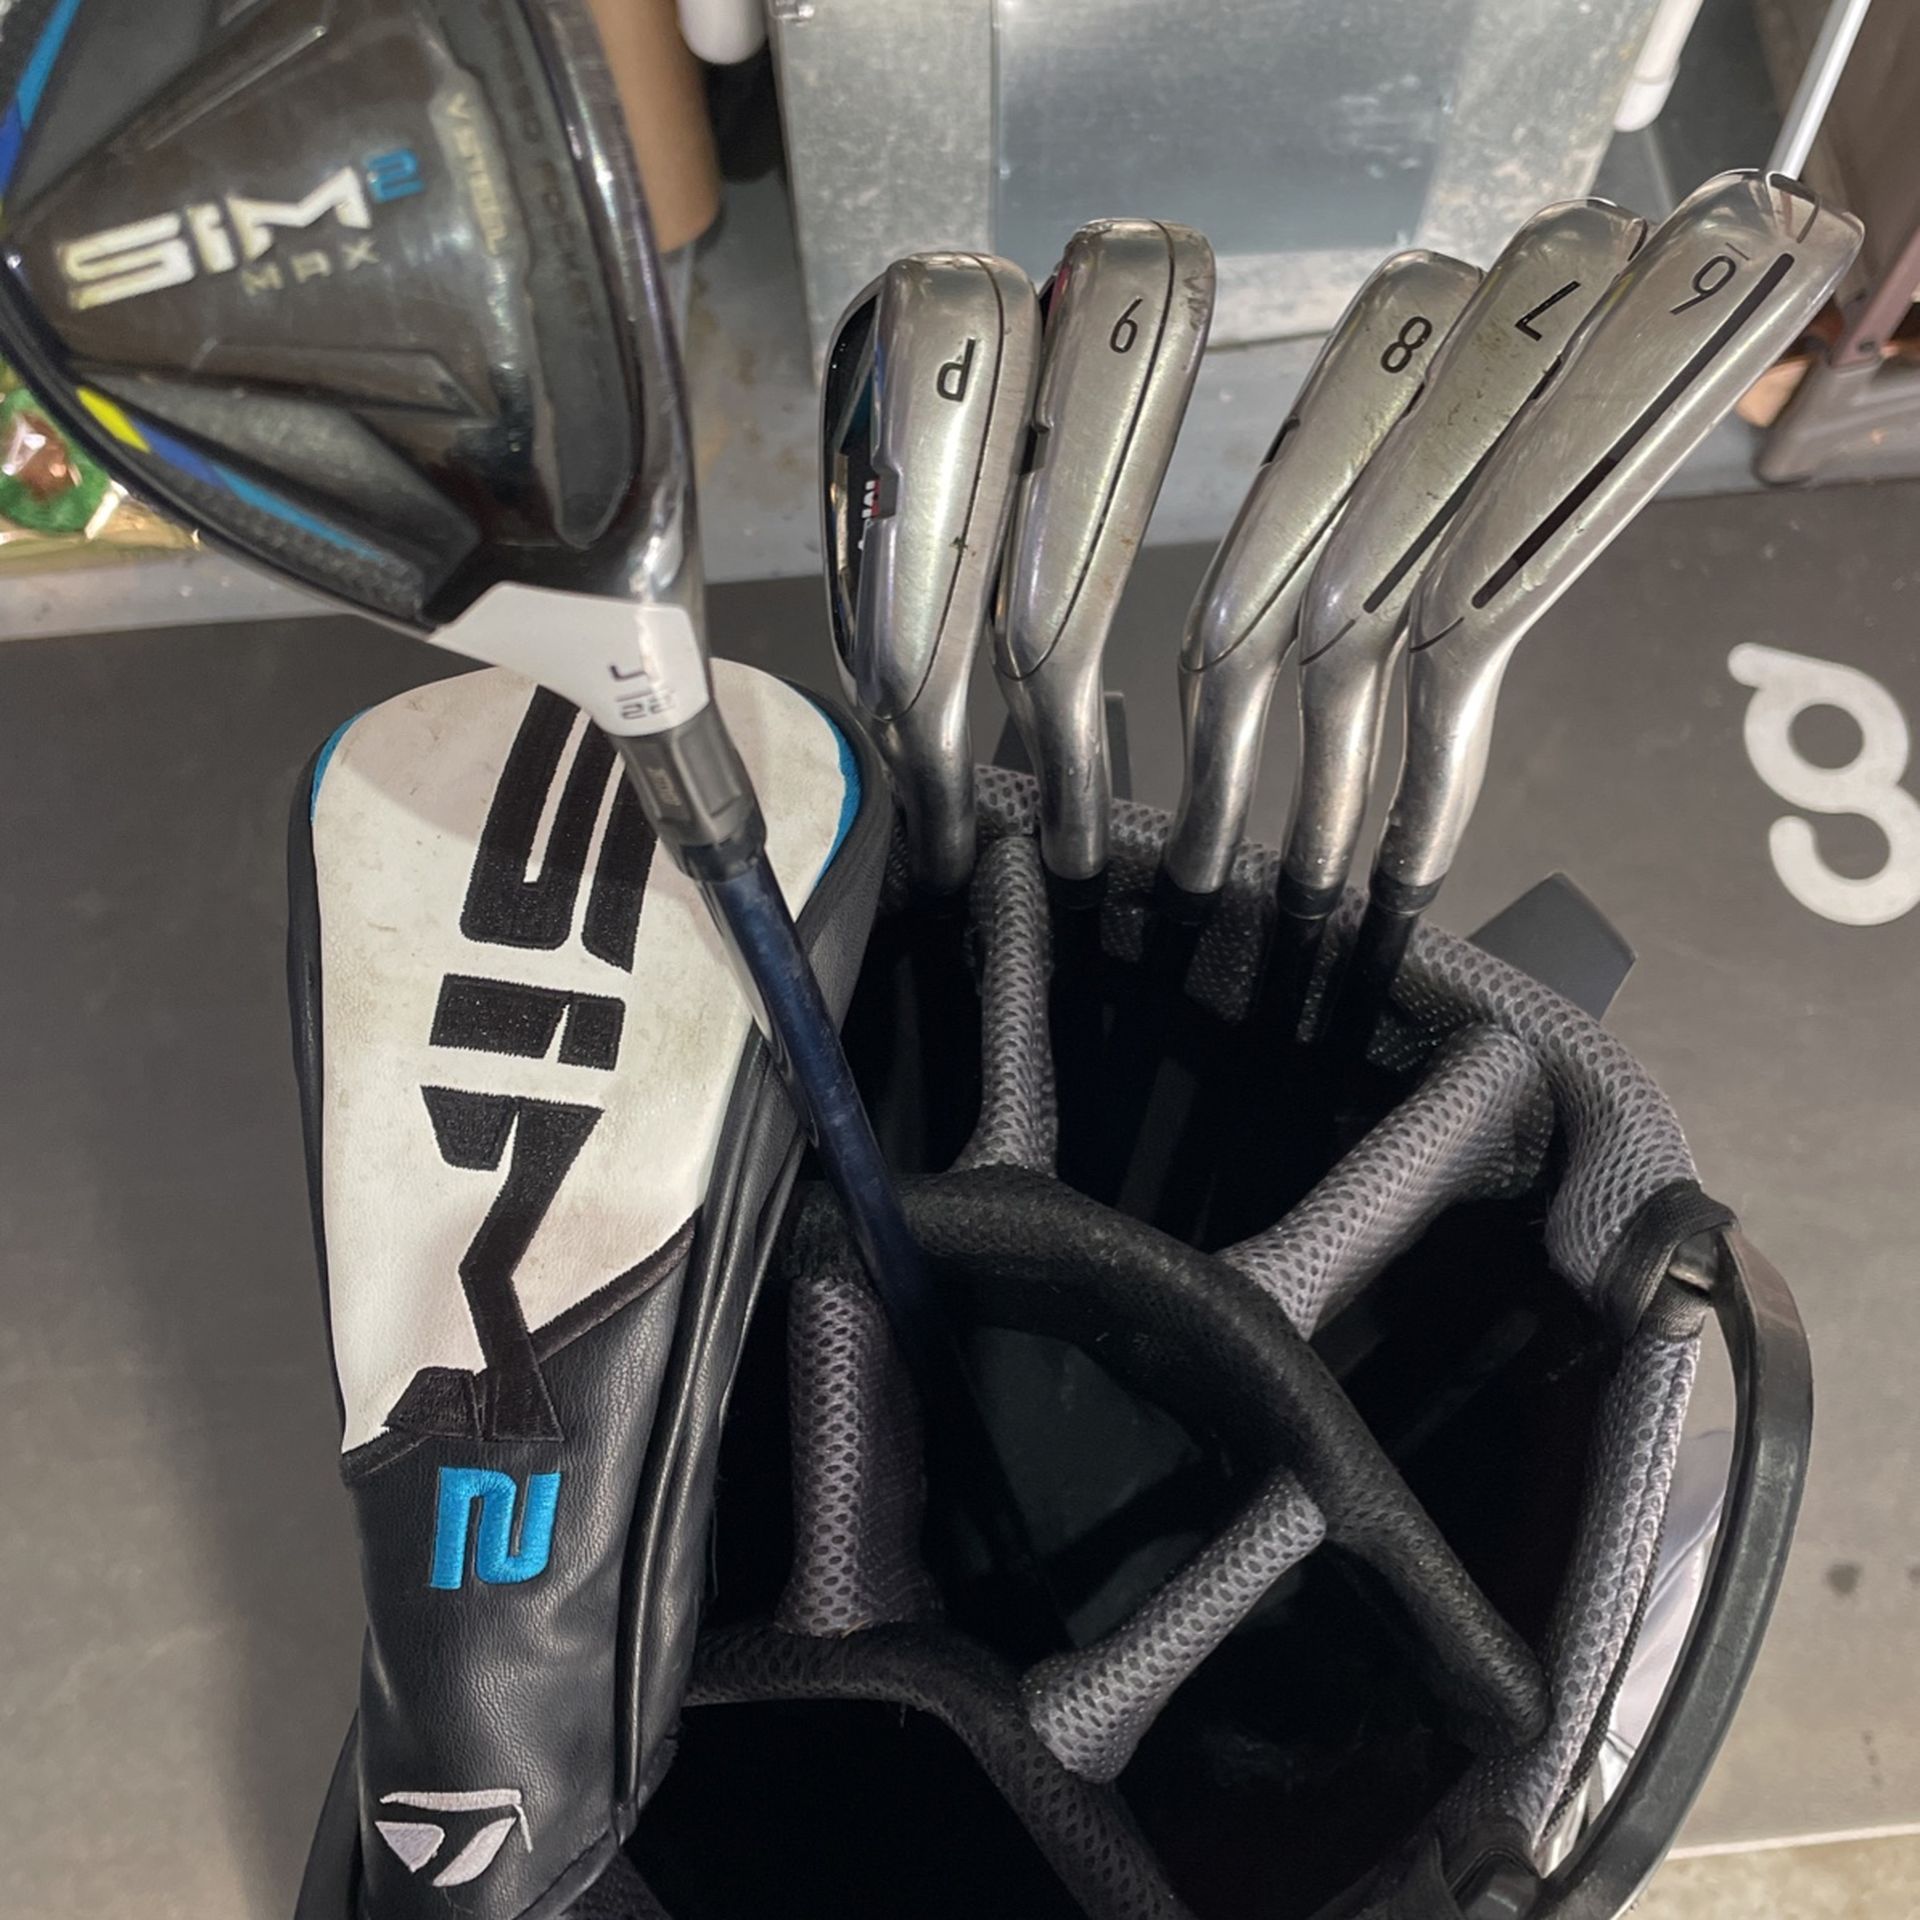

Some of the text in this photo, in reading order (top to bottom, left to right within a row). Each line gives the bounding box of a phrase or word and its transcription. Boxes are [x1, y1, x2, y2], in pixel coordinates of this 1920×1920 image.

[1515, 281, 1581, 342] 7
[936, 339, 977, 402] P
[1380, 316, 1433, 374] 8
